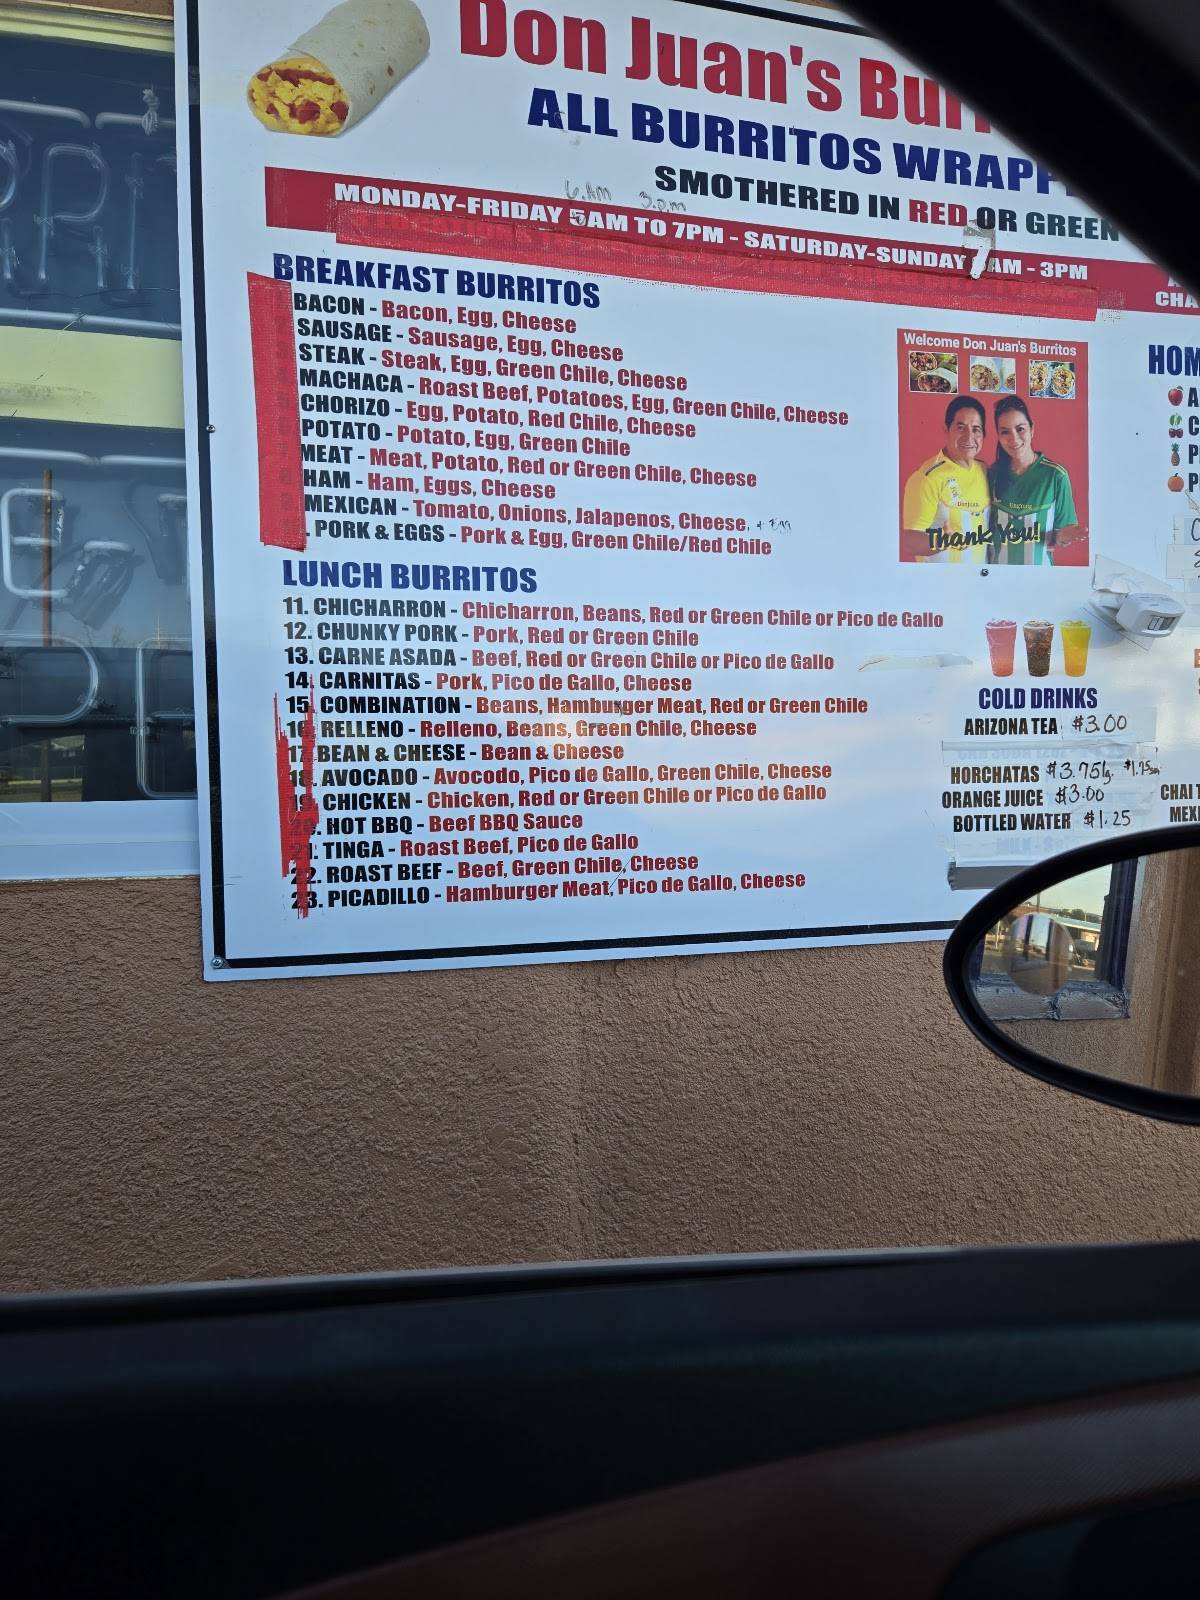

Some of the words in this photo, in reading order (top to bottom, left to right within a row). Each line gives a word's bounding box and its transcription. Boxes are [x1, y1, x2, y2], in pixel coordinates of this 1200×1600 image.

[460, 0, 606, 74] Don
[625, 16, 842, 111] Juan's
[527, 87, 618, 137] ALL
[632, 102, 881, 175] BURRITOS
[893, 143, 1077, 197] WRAPP
[655, 165, 859, 215] SMOTHERED
[868, 194, 900, 220] IN
[908, 199, 967, 226] RED
[976, 206, 1017, 232] OR
[1025, 212, 1120, 242] GREEN
[334, 183, 563, 224] MONDAY-FRIDAY
[569, 209, 628, 232] 5AM
[634, 216, 667, 237] TO
[672, 221, 724, 244] 7PM
[744, 231, 966, 270] SATURDAY-SUNDAY
[1040, 261, 1088, 280] 3PM
[272, 252, 449, 297] BREAKFAST
[456, 269, 600, 308] BURRITOS
[293, 293, 364, 317] BACON
[381, 299, 452, 324] Bacon,
[457, 306, 497, 328] Egg,
[502, 310, 576, 333] Cheese
[297, 319, 392, 345] SAUSAGE
[408, 326, 502, 353] Sausage,
[507, 334, 546, 357] Egg,
[551, 338, 623, 361] Cheese
[904, 332, 960, 349] Welcome
[963, 337, 987, 351] Don
[989, 340, 1027, 353] Juan's
[1029, 343, 1077, 357] Burritos
[298, 344, 365, 367] STEAK
[381, 349, 446, 373] Steak,
[450, 354, 491, 376] Egg,
[495, 358, 555, 379] Green
[559, 363, 613, 386] Chile,
[617, 368, 687, 391] Cheese
[299, 369, 403, 395] MACHACA
[419, 376, 478, 398] Roast
[482, 381, 532, 404] Beef,
[536, 385, 627, 411] Potatoes,
[632, 393, 668, 414] Egg,
[672, 396, 726, 417] Green
[730, 401, 779, 422] Chile,
[783, 405, 848, 425] Cheese
[300, 394, 389, 418] CHORIZO
[406, 400, 448, 422] Egg,
[452, 404, 523, 427] Potato,
[528, 409, 564, 428] Red
[569, 412, 622, 434] Chile,
[626, 416, 695, 437] Cheese
[302, 419, 380, 442] POTATO
[397, 424, 470, 448] Potato,
[474, 429, 514, 450] Egg,
[519, 432, 577, 453] Green
[581, 436, 630, 456] Chile
[300, 445, 353, 466] MEAT
[369, 447, 427, 470] Meat,
[431, 451, 503, 474] Potato,
[507, 455, 544, 474] Red
[549, 461, 569, 476] or
[574, 459, 630, 480] Green
[634, 463, 686, 484] Chile,
[690, 467, 756, 487] Cheese
[304, 469, 350, 490] HAM
[367, 472, 419, 494] Ham,
[423, 475, 476, 496] Eggs,
[481, 478, 555, 499] Cheese
[304, 493, 396, 516] MEXICAN
[412, 499, 494, 521] Tomato,
[498, 503, 571, 525] Onions,
[575, 507, 674, 530] Jalapenos,
[314, 519, 370, 539] PORK
[374, 524, 389, 540] &
[393, 522, 444, 542] EGGS
[460, 525, 506, 544] Pork
[510, 530, 524, 545] &
[528, 528, 567, 548] Egg,
[571, 530, 628, 549] Green
[632, 533, 722, 553] Chile/Red
[726, 537, 771, 555] Chile
[926, 524, 993, 550] Thank
[997, 521, 1041, 545] You!
[282, 559, 382, 588] LUNCH
[390, 563, 537, 593] BURRITOS
[282, 596, 308, 614] 11.
[313, 597, 445, 618] CHICHARRON
[462, 601, 578, 622] Chicharron,
[582, 604, 645, 624] Beans,
[649, 606, 683, 623] Red
[688, 610, 707, 623] or
[710, 607, 763, 624] Green
[767, 609, 811, 625] Chile
[815, 612, 833, 626] or
[837, 610, 873, 626] Pico
[877, 611, 897, 627] de
[901, 611, 943, 627] Gallo
[319, 671, 420, 690] CARNITAS
[436, 672, 487, 691] Pork,
[492, 673, 534, 690] Pico
[538, 673, 562, 690] de
[567, 673, 619, 692] Gallo,
[623, 674, 691, 691] Cheese
[978, 687, 1025, 709] COLD
[1030, 687, 1097, 708] DRINKS
[320, 719, 403, 737] RELLENO
[420, 720, 502, 738] Relleno,
[506, 720, 571, 738] Beans,
[576, 719, 631, 736] Green
[635, 719, 686, 737] Chile,
[690, 719, 756, 736] Cheese
[964, 717, 1028, 735] ARIZONA
[1030, 717, 1058, 734] TEA
[1072, 714, 1127, 733] $3.00
[950, 765, 1039, 784] HORCHATAS
[941, 790, 1001, 808] ORANGE
[1003, 789, 1043, 807] JUICE
[1055, 783, 1105, 805] $3.00
[1160, 783, 1193, 801] CHAI
[326, 816, 366, 835] HOT
[371, 815, 412, 834] BBQ
[429, 814, 475, 832] Beef
[479, 813, 518, 832] BBQ
[523, 812, 582, 829] Sauce
[953, 813, 1017, 832] BOTTLED
[1020, 812, 1072, 830] WATER
[1083, 809, 1131, 829] $1.25
[322, 840, 384, 859] TINGA
[400, 839, 459, 856] Roast
[463, 836, 513, 855] Beef,
[517, 835, 559, 853] Pico
[563, 834, 586, 851] de
[591, 833, 638, 850] Gallo
[326, 864, 393, 883] ROAST
[397, 862, 442, 880] BEEF
[458, 860, 507, 878] Beef,
[512, 859, 569, 876] Green
[574, 856, 626, 874] Chile,
[630, 855, 698, 872] Cheese
